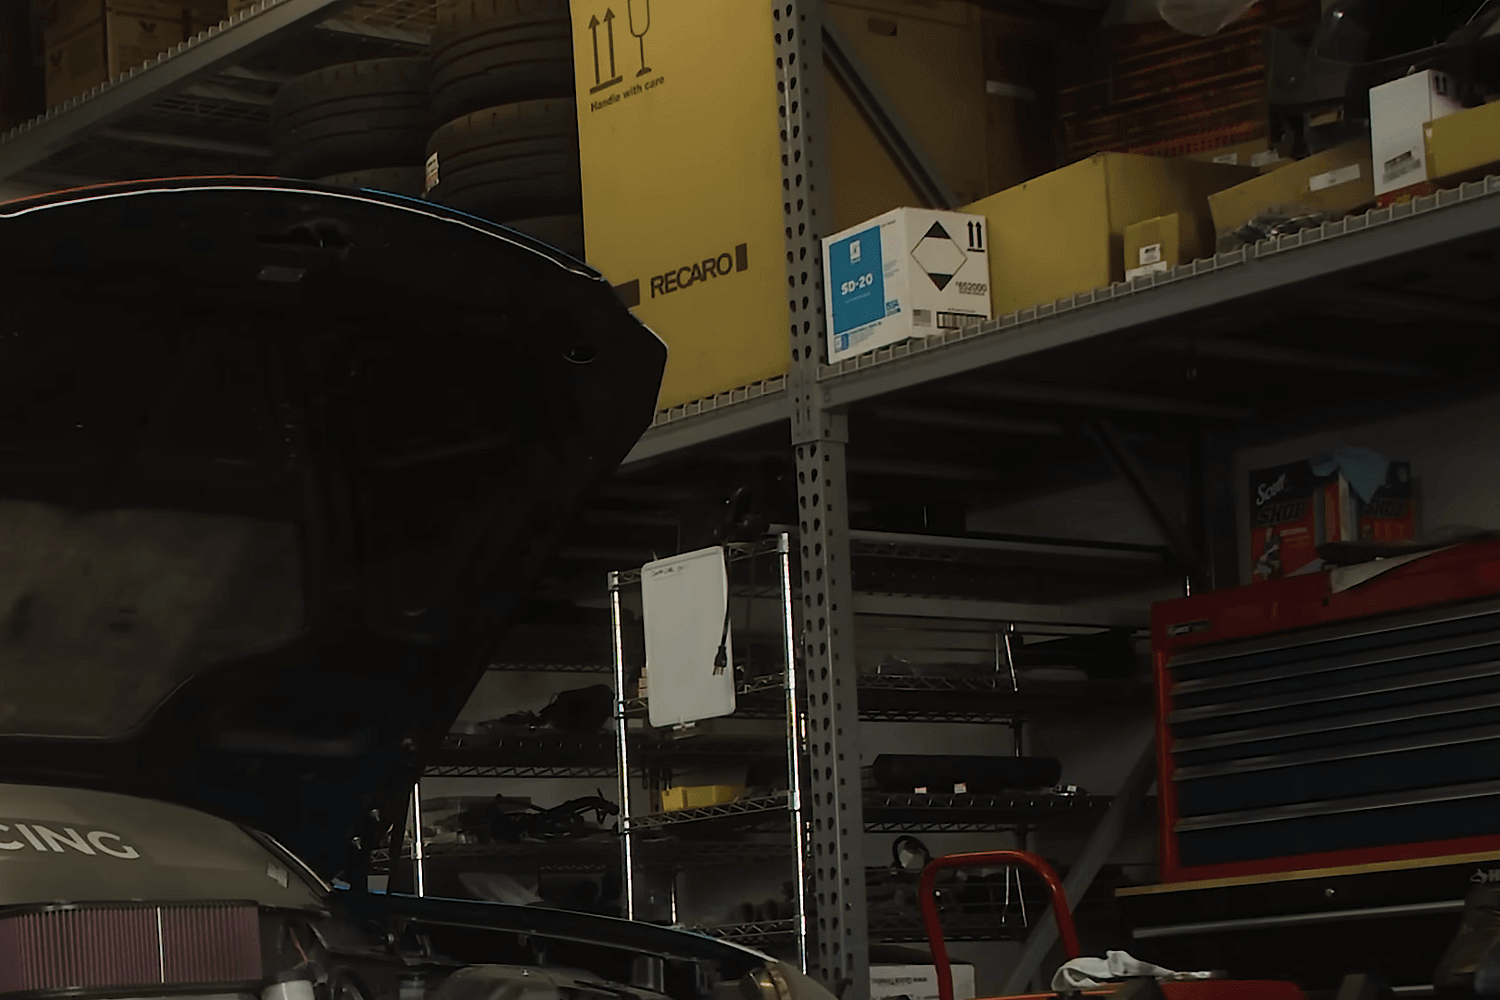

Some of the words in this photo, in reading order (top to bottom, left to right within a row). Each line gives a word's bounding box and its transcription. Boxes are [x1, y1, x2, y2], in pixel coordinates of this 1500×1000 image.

[590, 93, 621, 112] Handle
[622, 83, 643, 99] with
[644, 76, 665, 91] care
[650, 252, 733, 299] RECARO
[840, 272, 874, 296] SD-20
